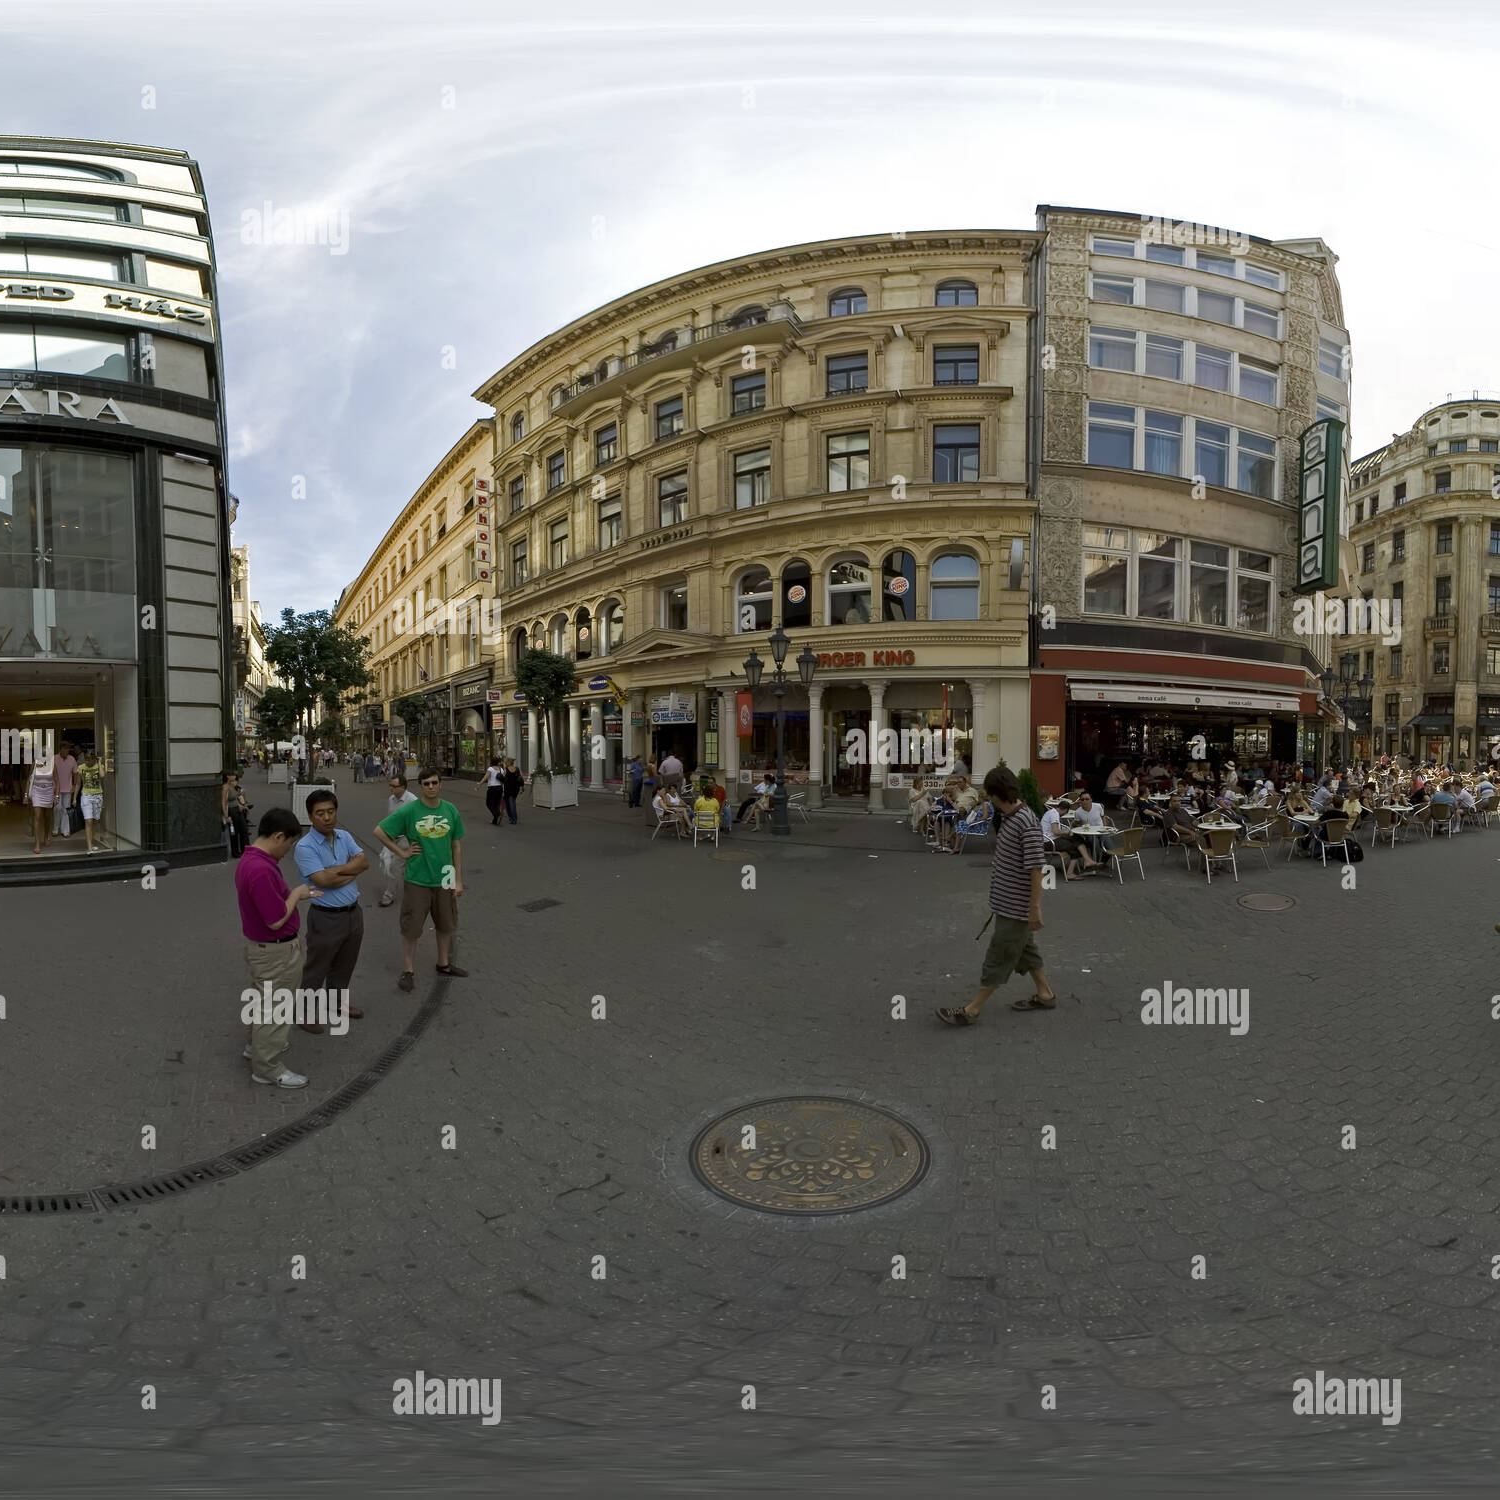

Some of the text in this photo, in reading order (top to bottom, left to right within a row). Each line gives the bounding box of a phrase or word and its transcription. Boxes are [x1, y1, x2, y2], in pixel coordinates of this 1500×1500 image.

[104, 293, 206, 325] HÁZ
[1302, 434, 1325, 578] anna
[478, 496, 489, 580] photo
[873, 650, 915, 666] KING
[924, 780, 938, 788] 330
